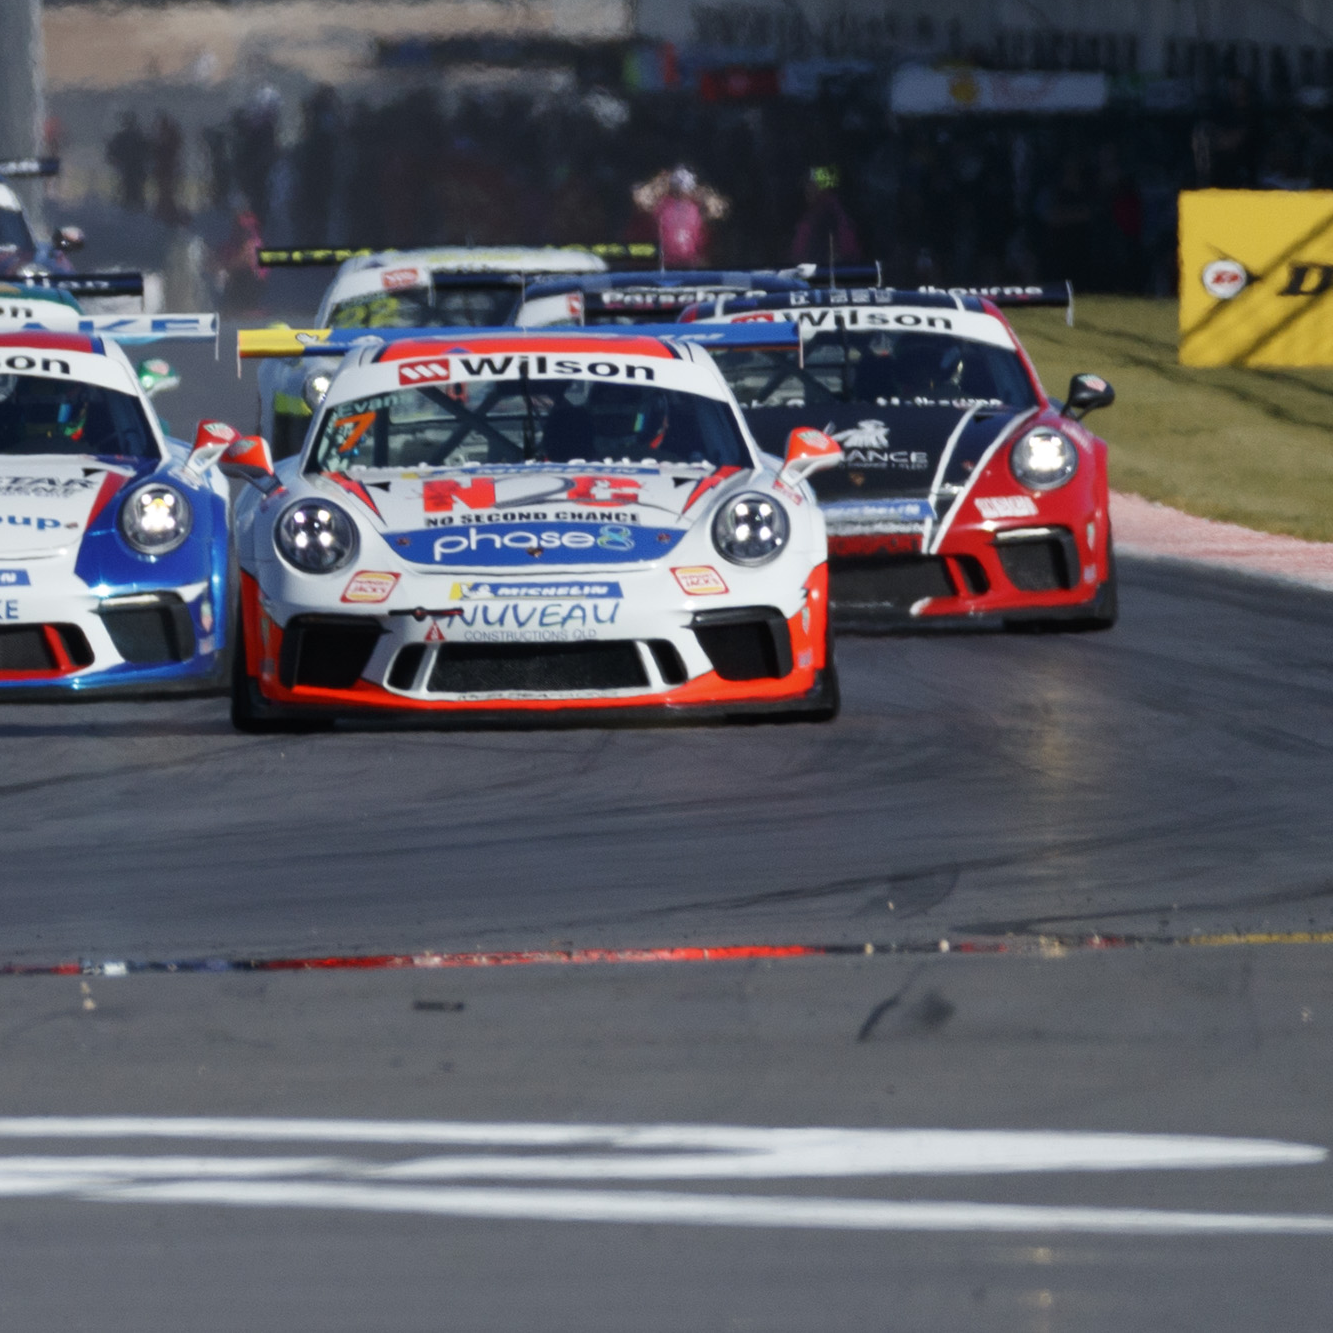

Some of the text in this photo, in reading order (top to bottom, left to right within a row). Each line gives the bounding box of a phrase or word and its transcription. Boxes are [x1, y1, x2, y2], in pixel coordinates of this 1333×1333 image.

[784, 309, 952, 330] Wilson
[460, 355, 656, 381] Wilson
[335, 410, 377, 453] 7
[461, 512, 548, 525] SECOND
[497, 585, 610, 596] MICHELIN
[446, 601, 620, 628] NUVEAU
[463, 629, 568, 642] CONSTRUCTIONS
